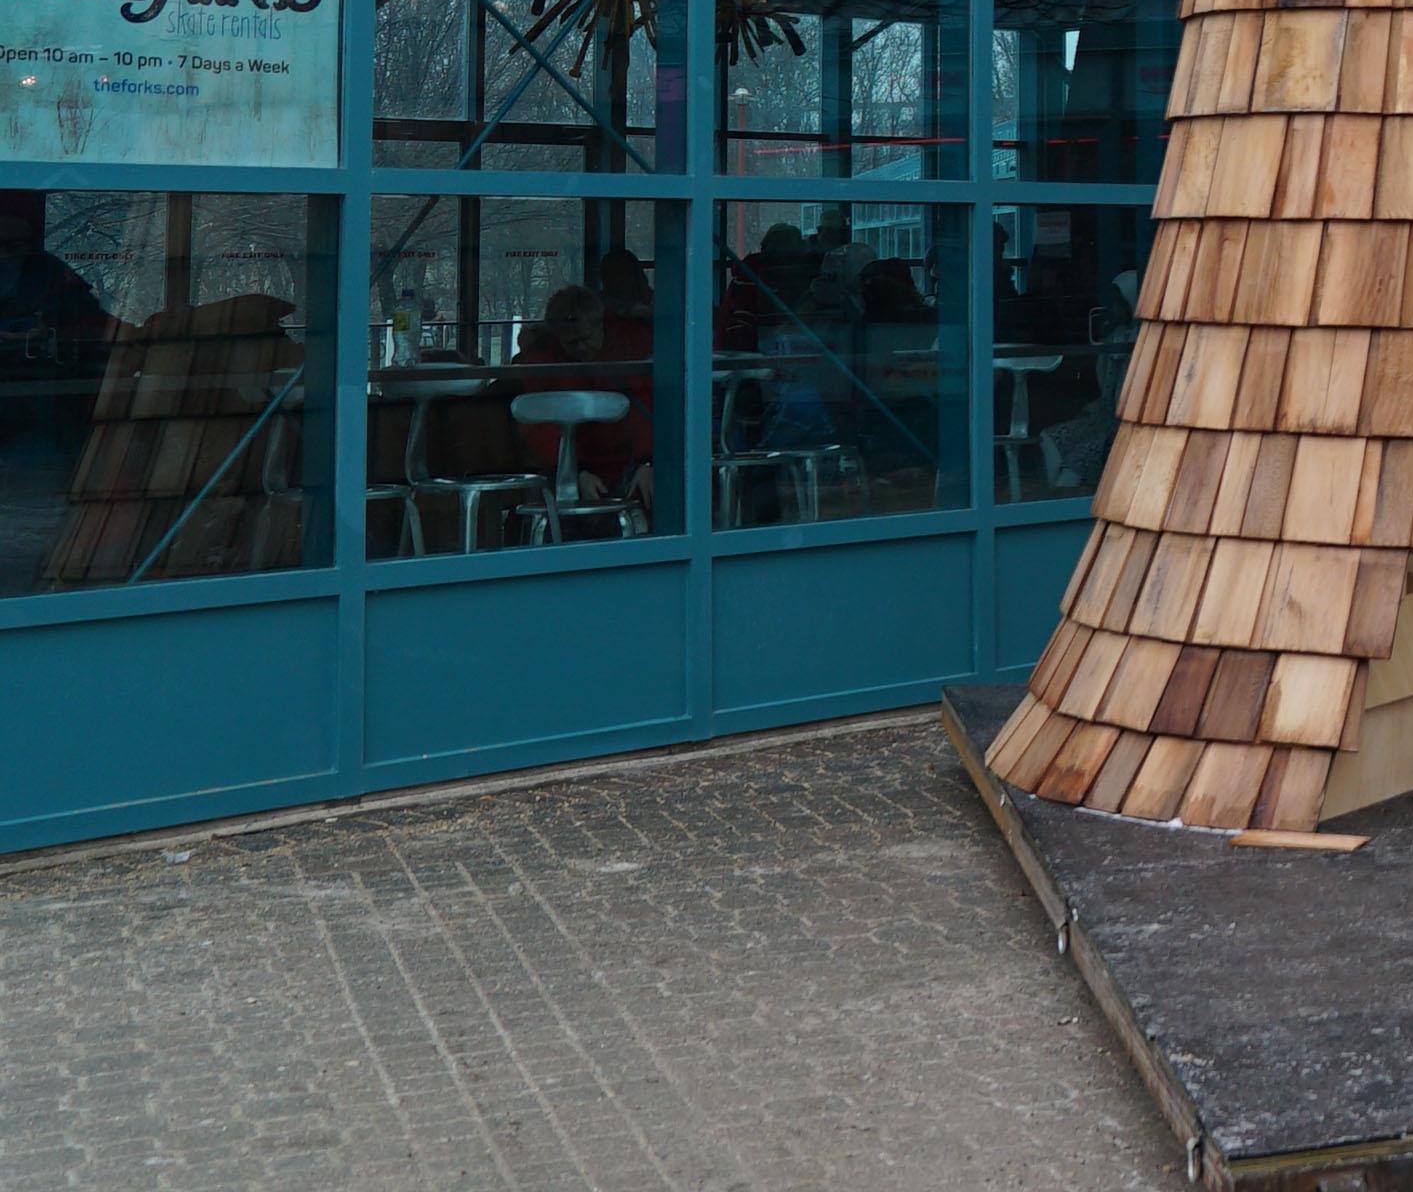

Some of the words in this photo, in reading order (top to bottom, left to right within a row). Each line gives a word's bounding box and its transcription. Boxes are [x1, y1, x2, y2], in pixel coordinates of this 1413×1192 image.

[166, 1, 216, 36] skate
[221, 6, 282, 40] rentals
[43, 48, 64, 62] 10
[68, 51, 94, 64] am
[113, 52, 133, 66] 10
[138, 56, 163, 70] pm
[177, 55, 188, 69] 7
[191, 56, 231, 73] Days
[235, 61, 244, 72] a
[248, 58, 290, 75] Week
[93, 78, 199, 97] theforks.com
